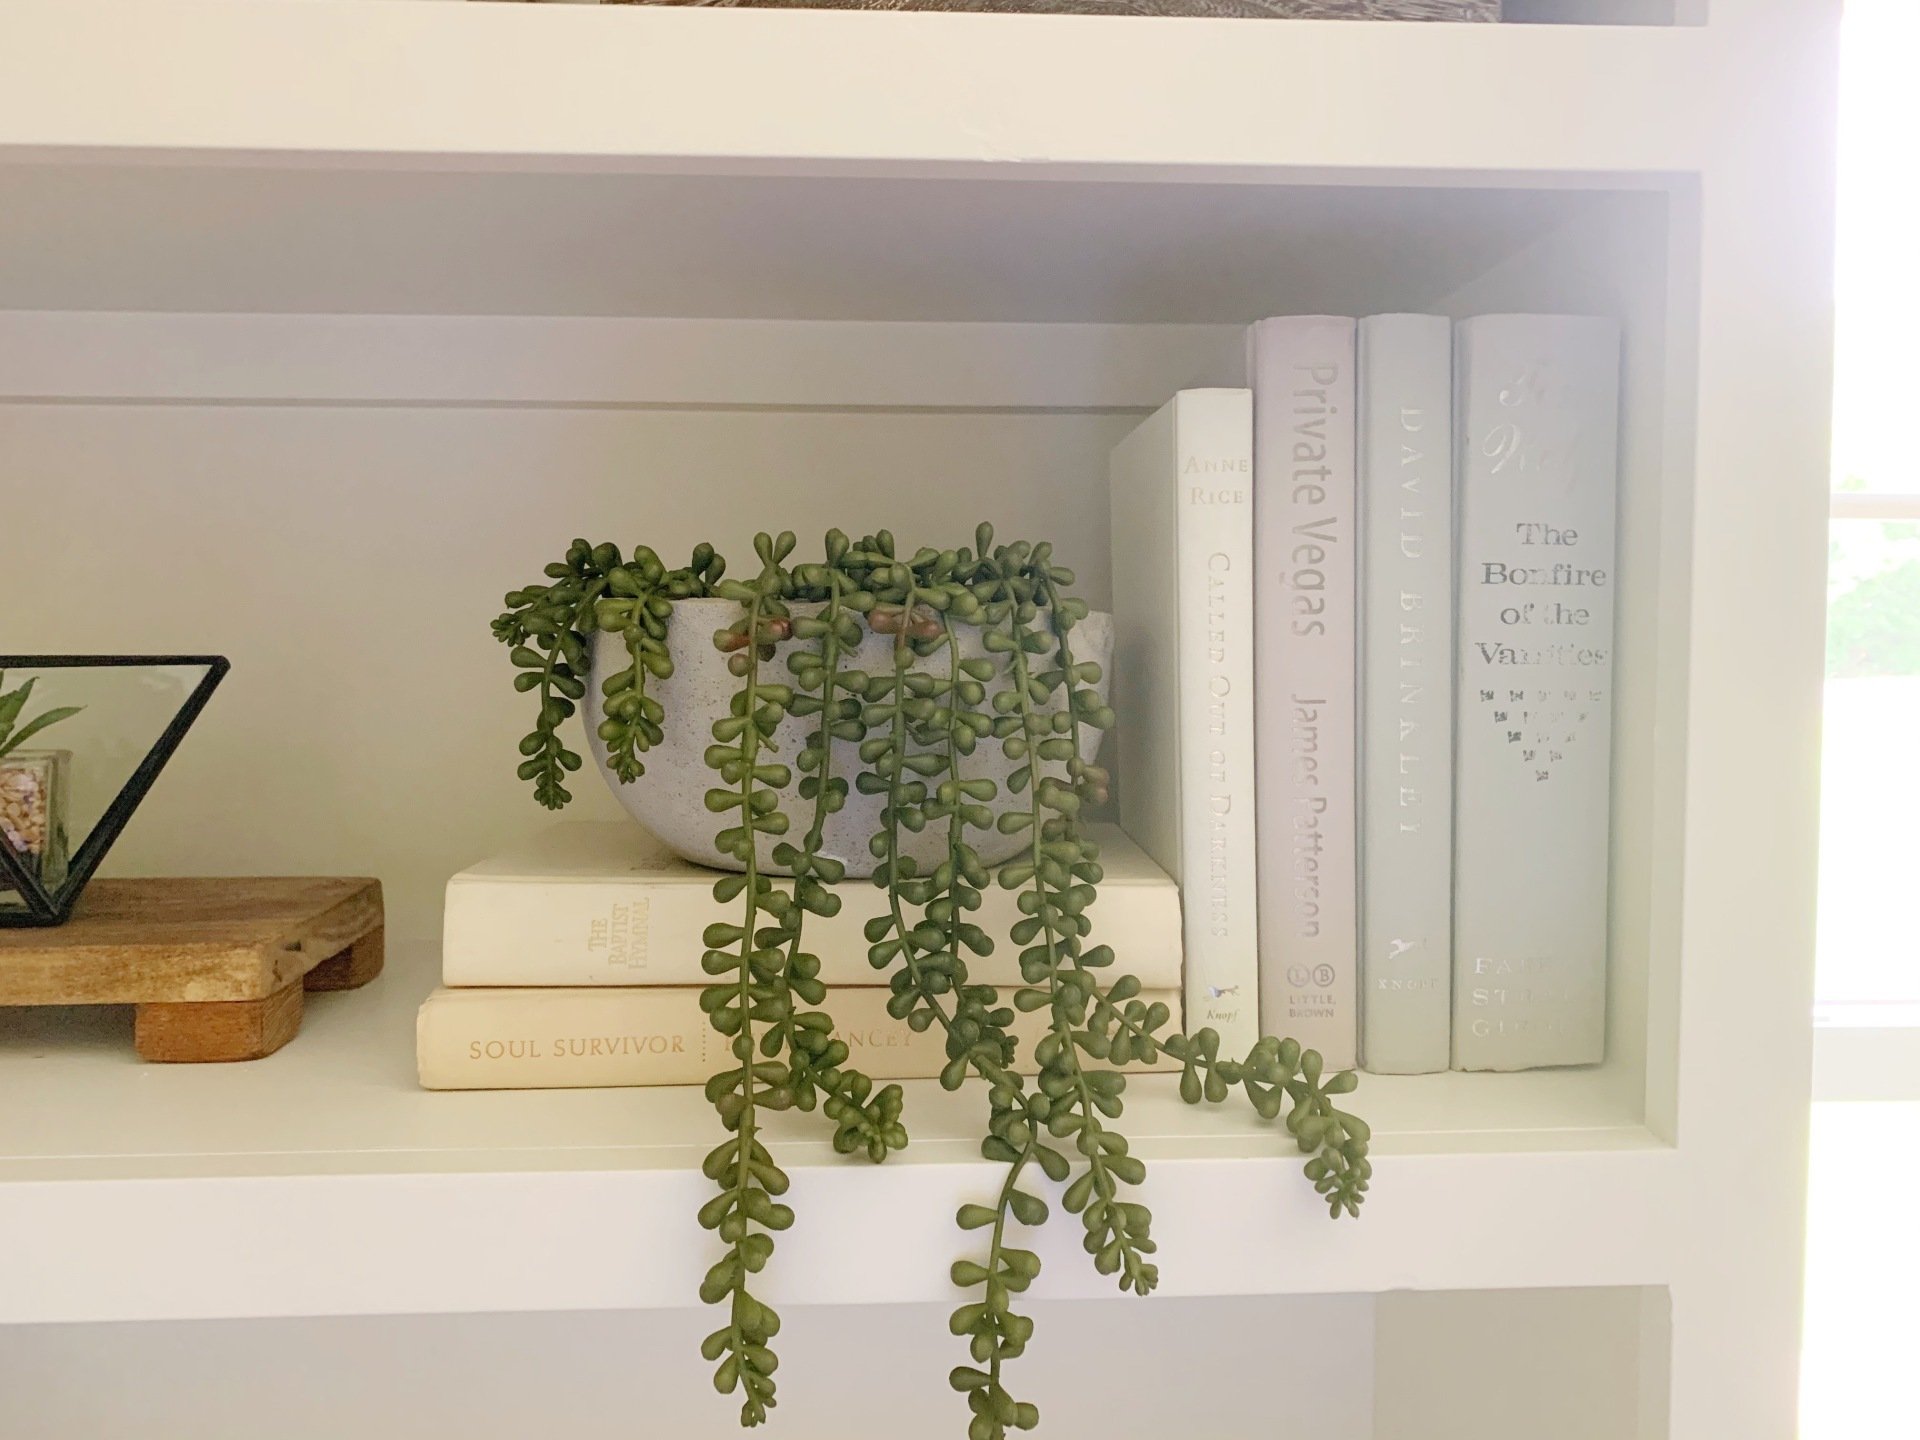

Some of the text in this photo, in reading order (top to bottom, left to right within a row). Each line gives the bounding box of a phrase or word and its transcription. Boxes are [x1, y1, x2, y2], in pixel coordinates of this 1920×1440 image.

[1184, 456, 1249, 474] ANNE
[1190, 486, 1245, 506] RICE
[1279, 362, 1338, 637] Private Vegas
[1516, 522, 1579, 546] The
[1481, 562, 1608, 586] Bonfire
[1207, 551, 1231, 664] CALLED
[1500, 602, 1590, 626] of the
[1400, 406, 1425, 839] DAVID BRINKLEY
[1290, 692, 1328, 939] James Patterson
[1208, 793, 1232, 938] DARKNESS
[588, 917, 608, 952] THE
[608, 904, 628, 966] BAPTIST
[1206, 1008, 1241, 1024] Knopf
[469, 1035, 686, 1060] SOUL SURVIVOR
[832, 1029, 914, 1049] ANCEY
